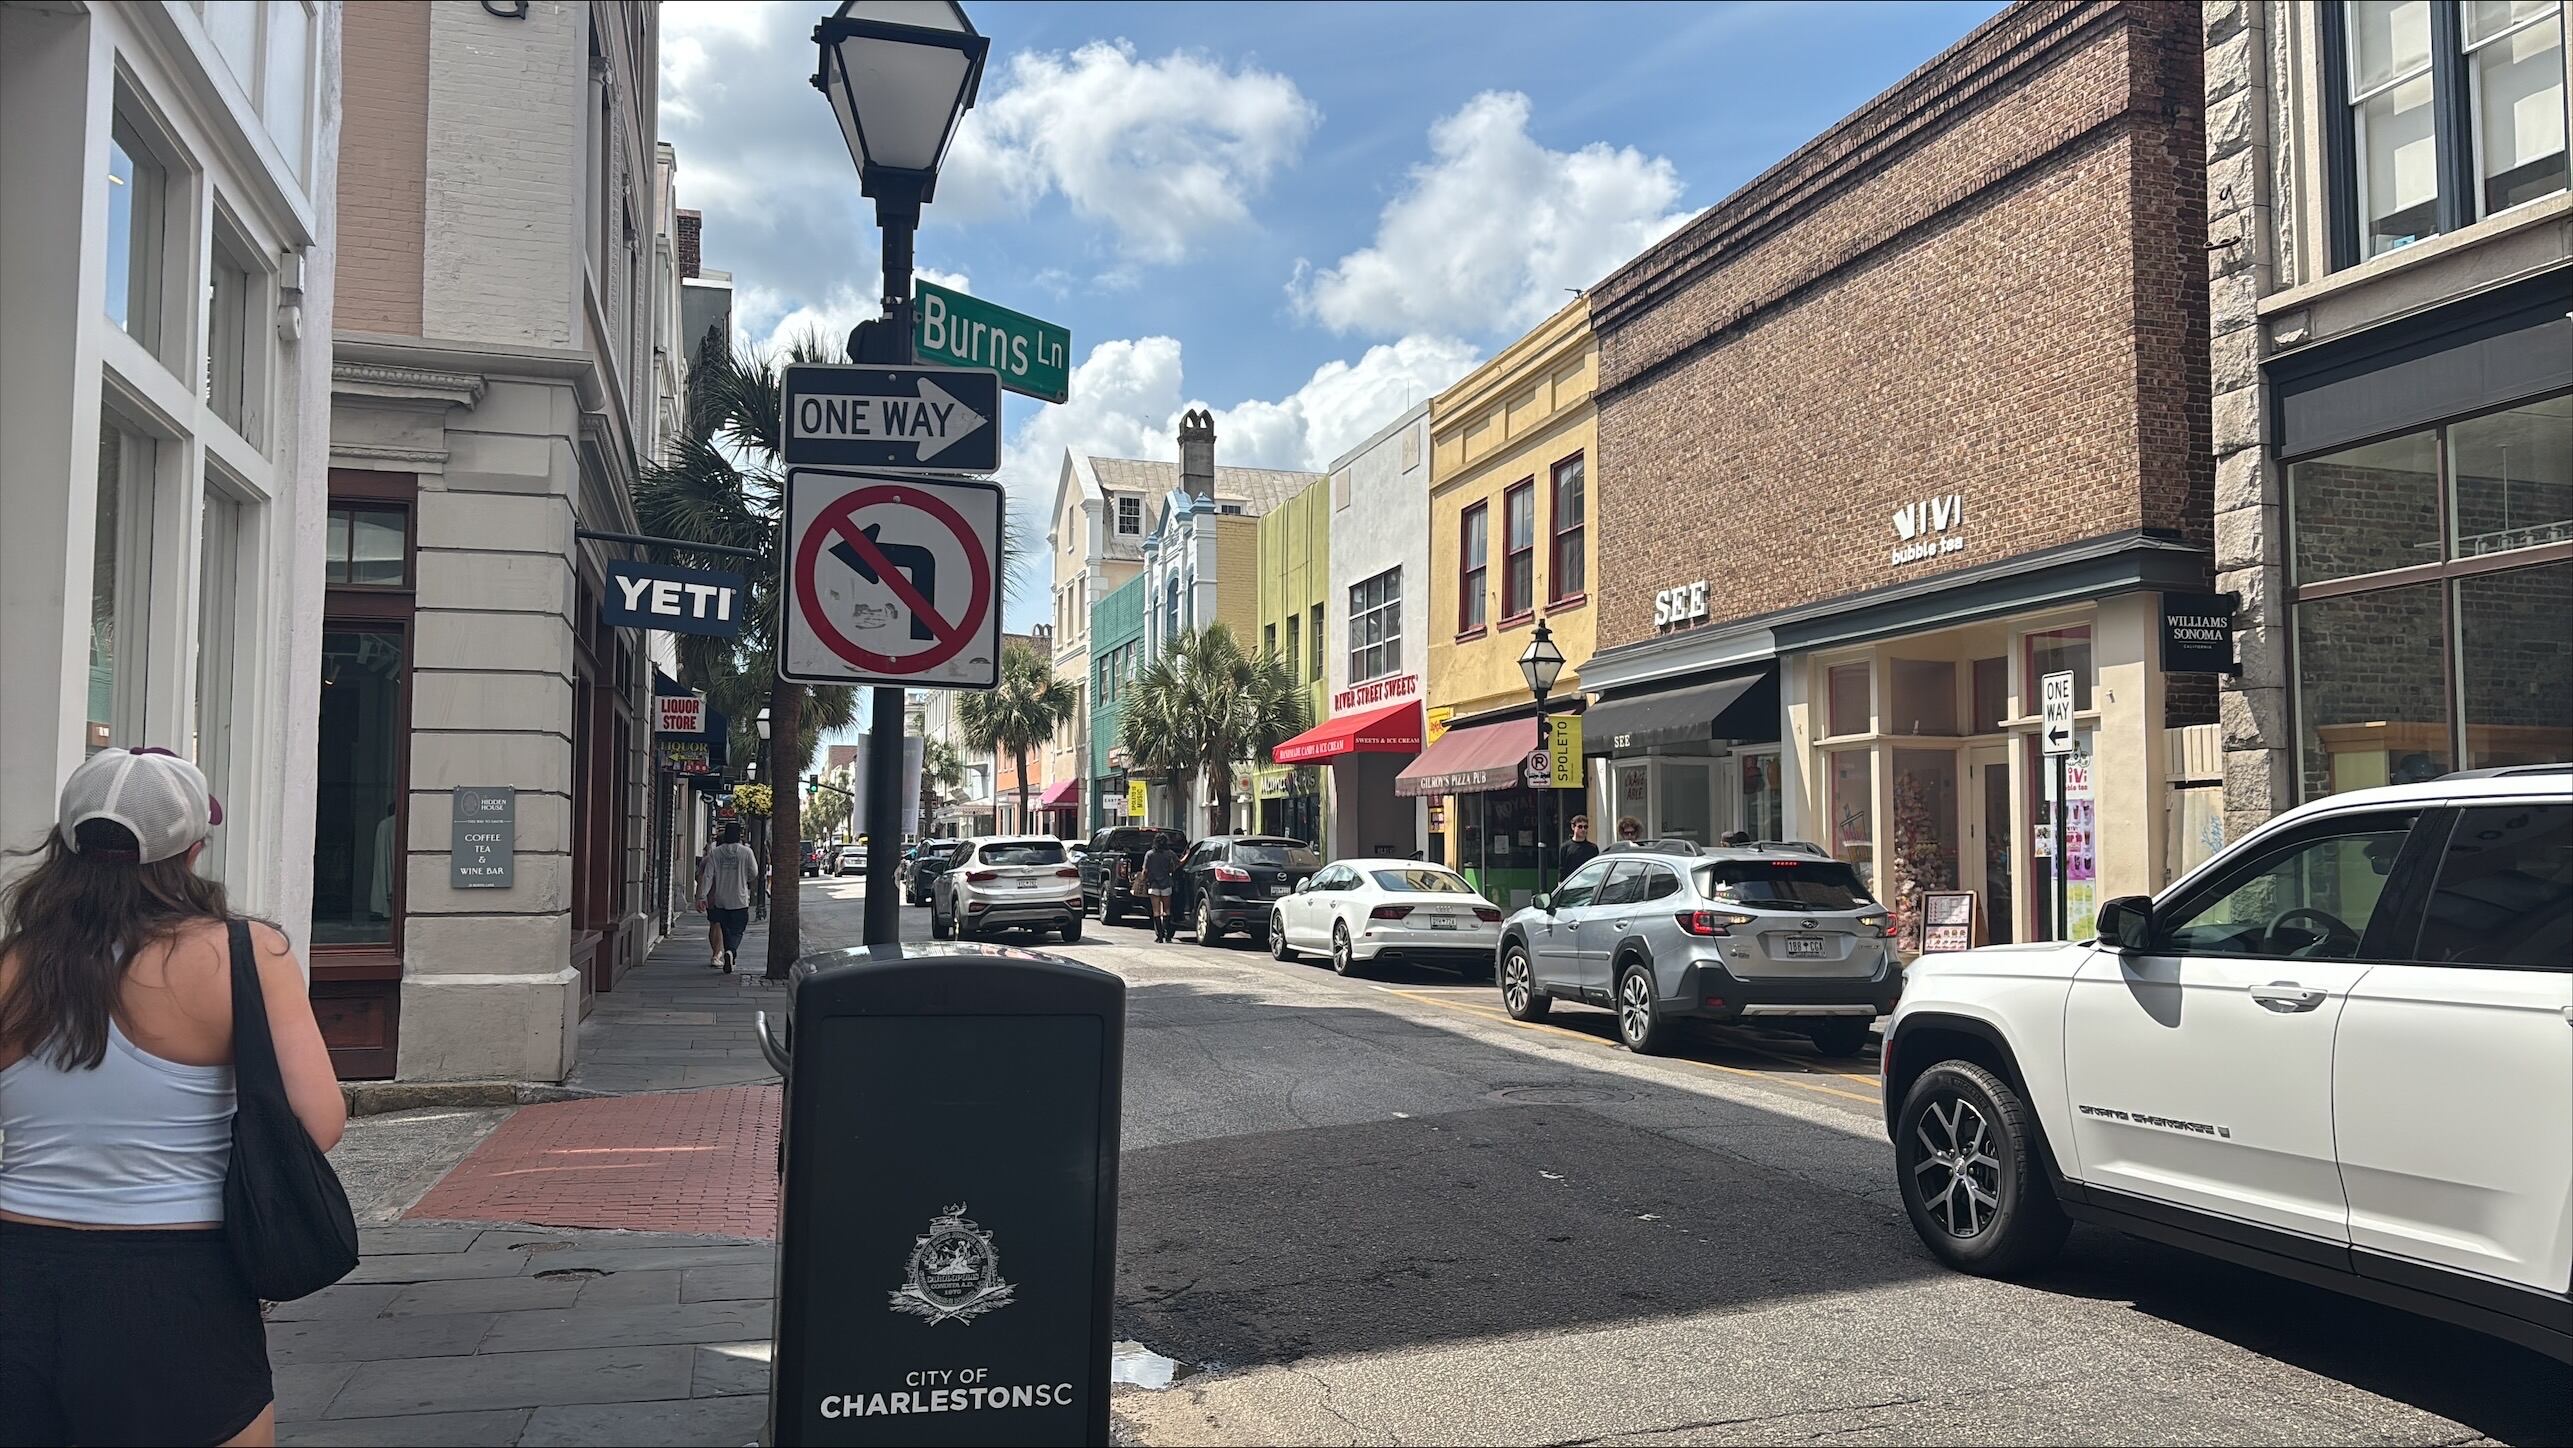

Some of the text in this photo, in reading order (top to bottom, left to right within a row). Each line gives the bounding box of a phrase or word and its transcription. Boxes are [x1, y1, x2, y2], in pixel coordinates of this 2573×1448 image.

[923, 293, 1063, 376] Burns Ln
[800, 397, 955, 437] ONE WAY
[1892, 494, 1962, 541] VIVI
[1892, 536, 1963, 566] bubble tea
[614, 575, 732, 621] YETI
[1654, 579, 1708, 626] SEE
[2167, 615, 2228, 628] WILLIAMS
[2173, 628, 2223, 640] SONOMA
[1334, 692, 1356, 711] RIVER
[1356, 683, 1383, 706] STREET
[2047, 680, 2069, 700] ONE
[661, 699, 699, 714] LIQUOR
[2047, 702, 2069, 721] WAY
[663, 715, 696, 730] STORE
[660, 742, 708, 752] LIQUOR
[1328, 740, 1344, 751] CREAM
[1614, 734, 1631, 748] SEE
[1557, 721, 1568, 782] SPOLETO
[1420, 772, 1487, 789] GILROY'S PIZZA PUB
[475, 845, 491, 853] TEA
[460, 867, 484, 875] WINE
[905, 1368, 988, 1387] CITY OF
